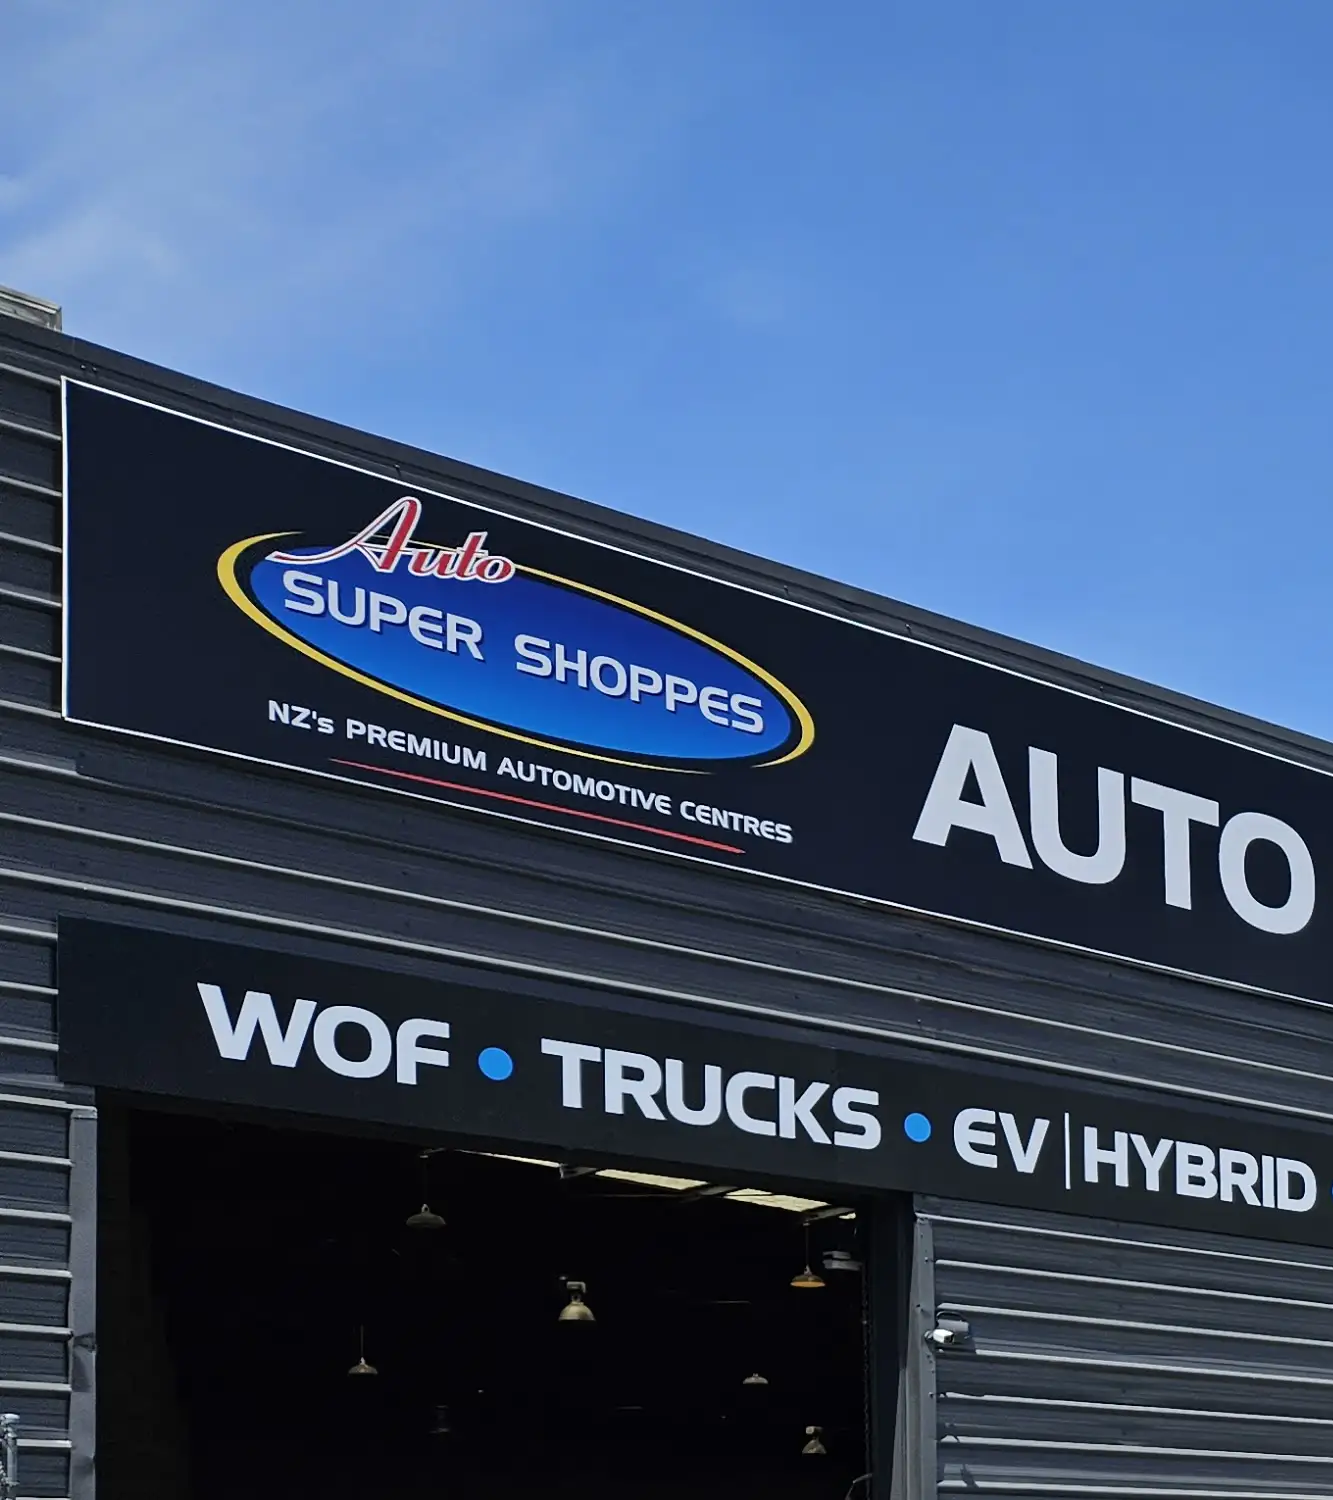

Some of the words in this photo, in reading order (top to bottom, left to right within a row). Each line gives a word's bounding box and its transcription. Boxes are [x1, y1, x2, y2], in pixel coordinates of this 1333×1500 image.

[265, 496, 515, 583] Auto
[284, 571, 483, 659] SUPER
[515, 635, 763, 732] SHOPPES
[269, 700, 333, 733] NZ's
[347, 719, 486, 771] PREMIUM
[497, 758, 672, 816] AUTOMOTIVE
[679, 801, 793, 844] CENTRES
[912, 723, 1316, 935] AUTO
[197, 983, 449, 1084] WOF
[542, 1038, 881, 1149] TRUCKS
